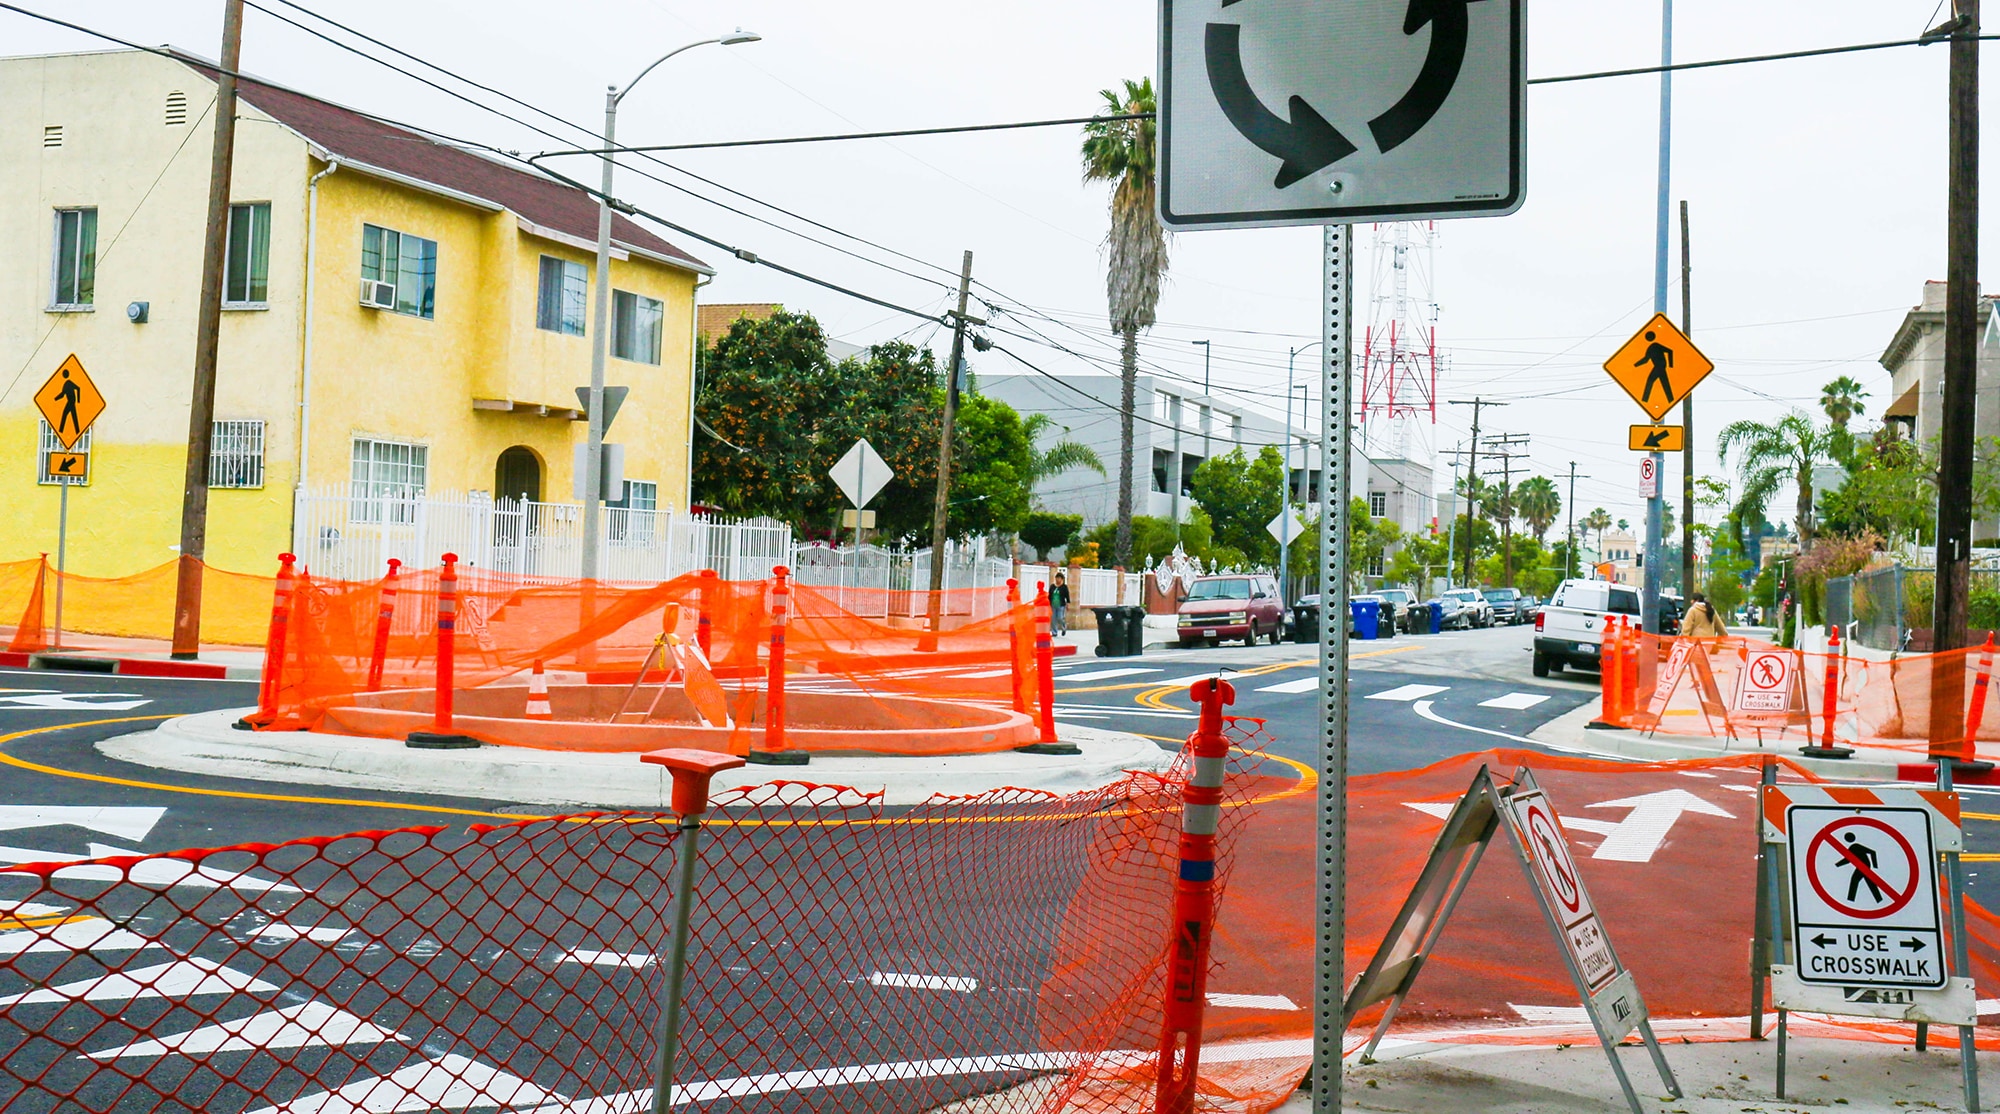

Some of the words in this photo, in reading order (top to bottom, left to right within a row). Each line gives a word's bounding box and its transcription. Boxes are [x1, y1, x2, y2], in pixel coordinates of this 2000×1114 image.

[1745, 701, 1781, 709] CROSSWALK
[1847, 934, 1889, 952] USE
[1811, 956, 1930, 977] CROSSWALK
